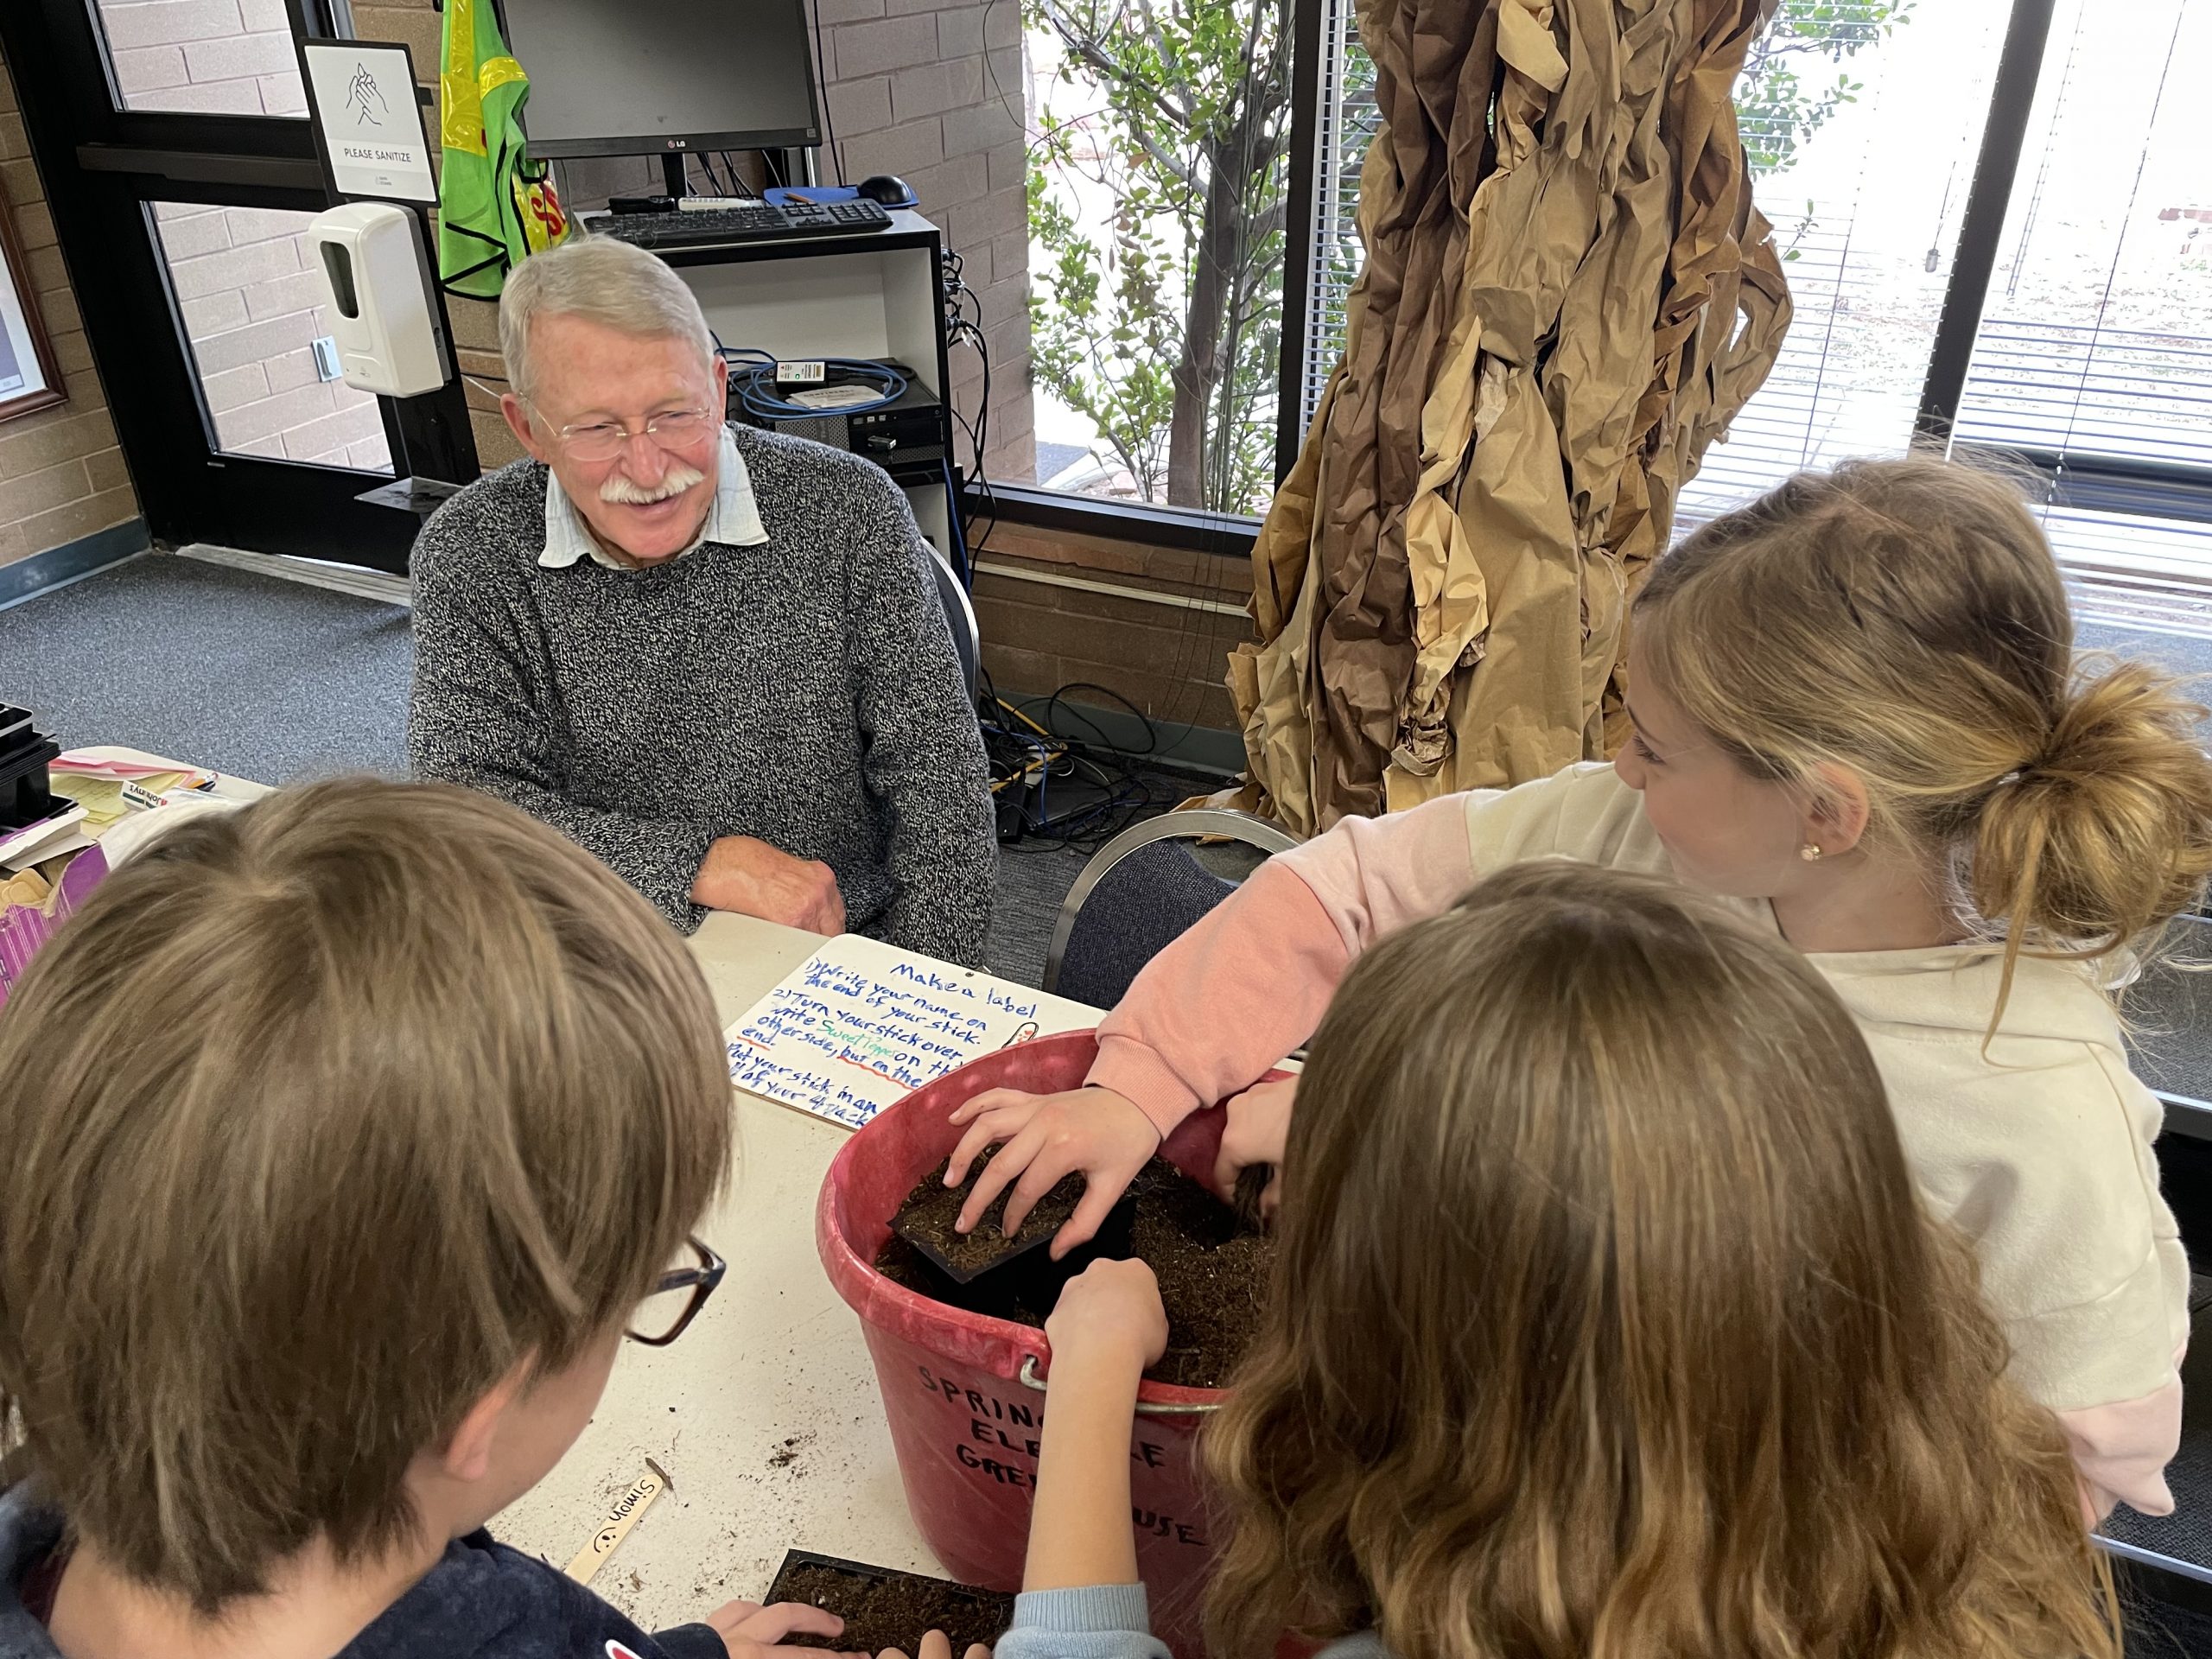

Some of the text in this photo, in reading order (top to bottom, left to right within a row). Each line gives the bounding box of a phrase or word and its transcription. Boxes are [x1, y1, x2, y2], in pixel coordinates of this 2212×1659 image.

[344, 148, 411, 162] PLEASE SANITIZE
[804, 974, 832, 988] the
[833, 983, 862, 997] end
[866, 995, 889, 1008] of
[880, 1006, 927, 1024] your
[869, 982, 915, 1001] your
[913, 997, 963, 1021] name
[967, 1019, 987, 1032] on
[890, 963, 960, 992] Make
[986, 987, 1037, 1019] label
[840, 1046, 869, 1063] but
[892, 1066, 923, 1088] the
[894, 1052, 921, 1067] on
[927, 1060, 950, 1077] th
[921, 1042, 963, 1059] over
[741, 1070, 771, 1088] of
[761, 1081, 807, 1100] your
[809, 1096, 826, 1110] 4
[747, 1056, 793, 1073] your
[837, 1086, 853, 1103] in
[609, 1479, 655, 1521] Simon
